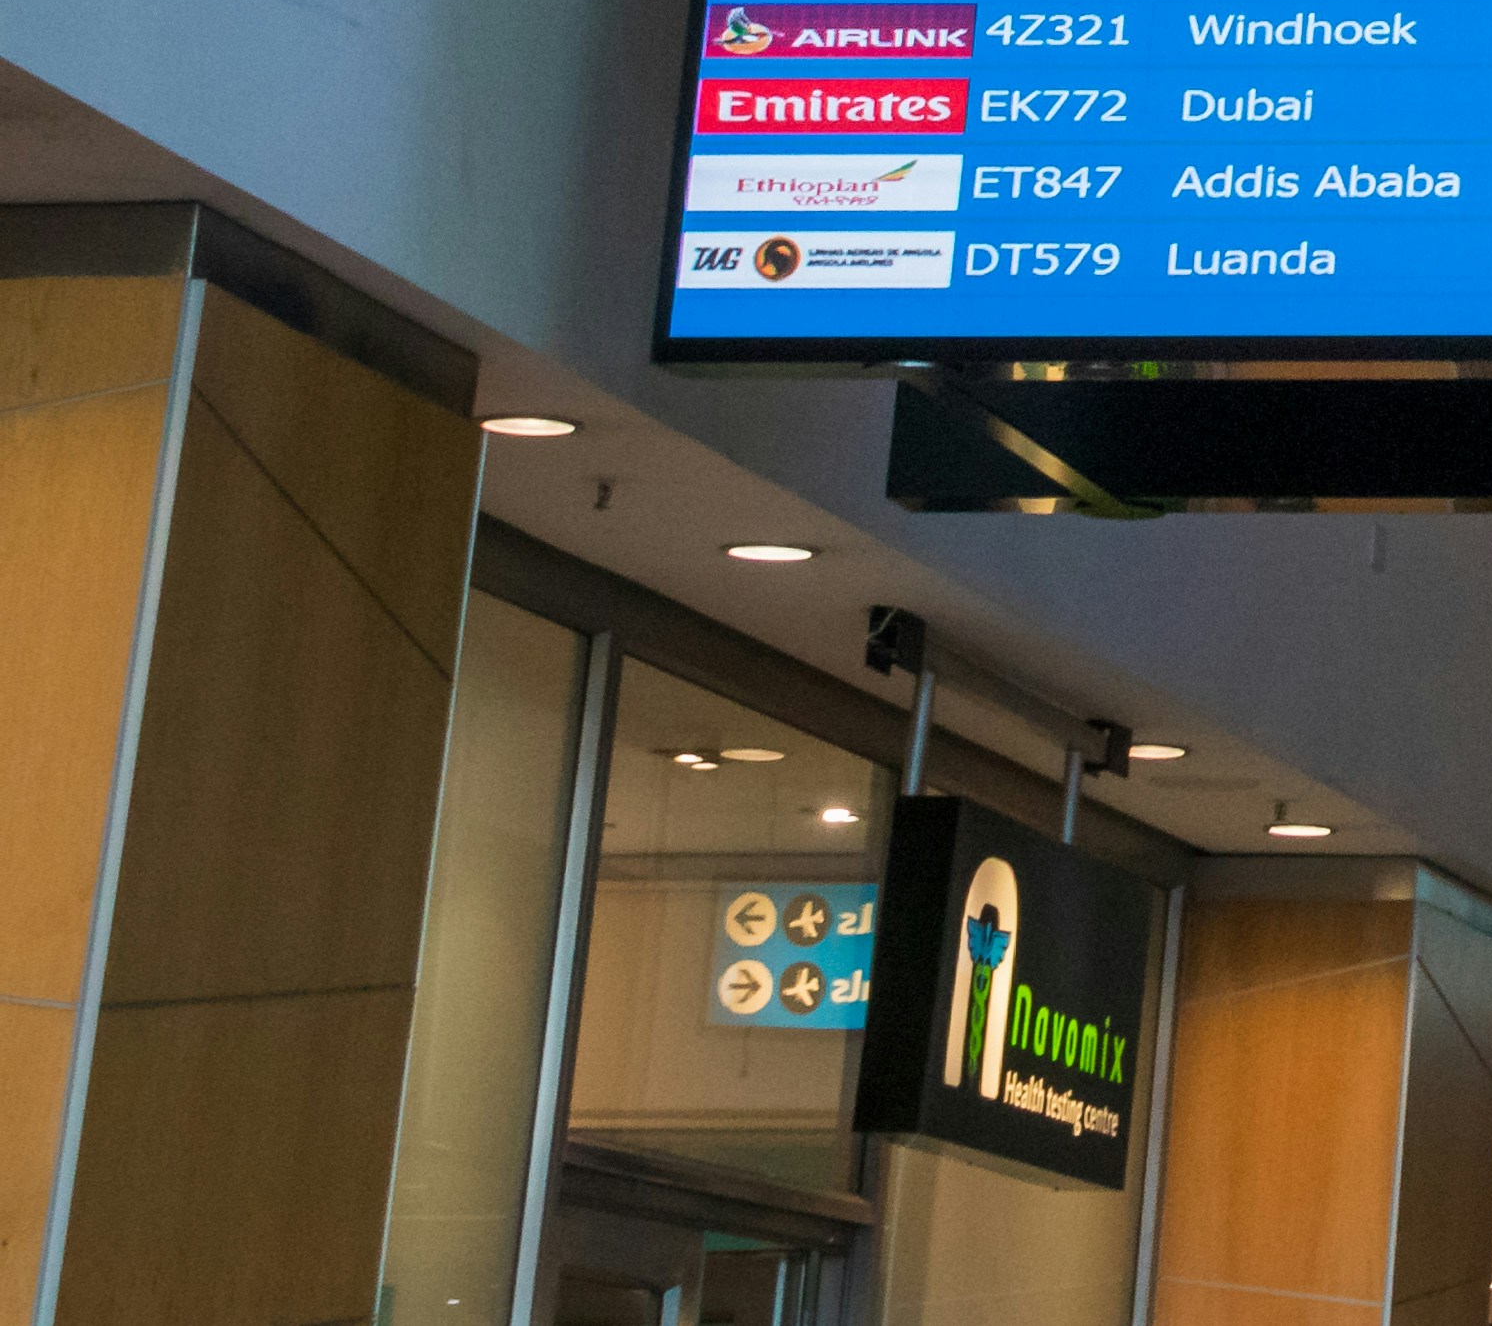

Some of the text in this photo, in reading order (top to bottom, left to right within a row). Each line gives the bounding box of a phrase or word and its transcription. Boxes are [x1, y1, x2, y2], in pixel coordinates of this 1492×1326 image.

[718, 90, 951, 122] Emirates
[982, 90, 1126, 121] EK772
[1183, 89, 1312, 121] Dubai
[1003, 1070, 1120, 1137] Health testing centre
